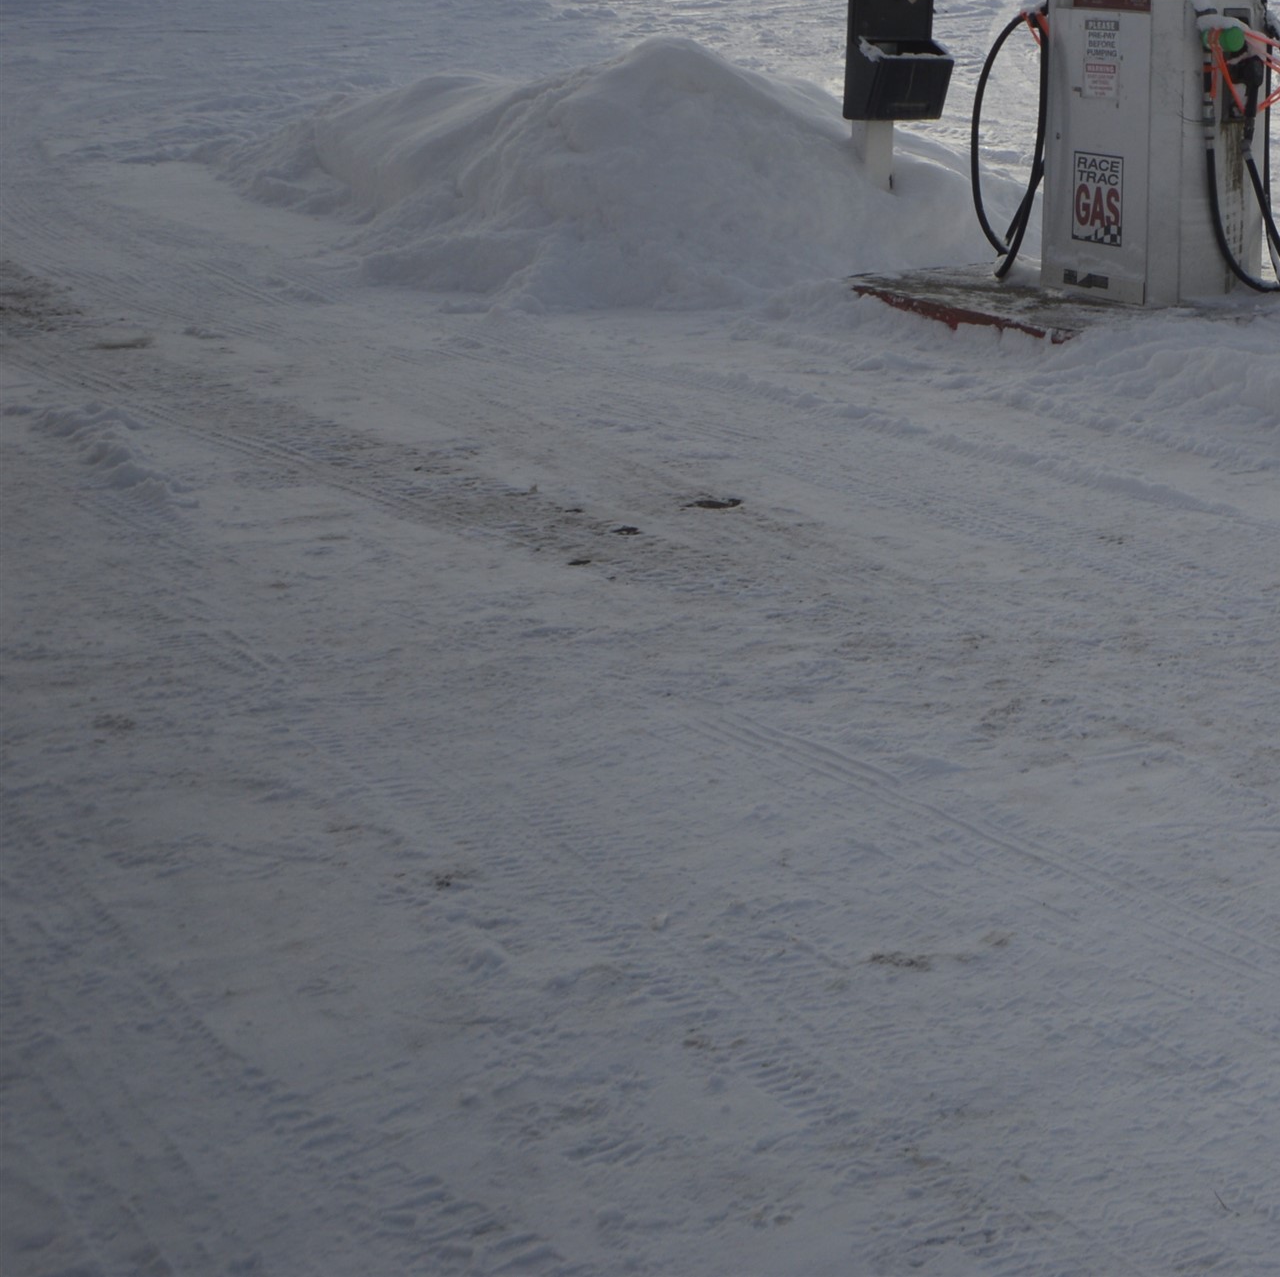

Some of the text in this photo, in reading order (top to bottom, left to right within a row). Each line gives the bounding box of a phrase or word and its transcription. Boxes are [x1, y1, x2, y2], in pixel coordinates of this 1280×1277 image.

[1089, 21, 1116, 30] PLEASE
[1088, 32, 1116, 40] PRE-PAY
[1088, 40, 1116, 49] BEFORE
[1087, 49, 1117, 57] PUMPING
[1077, 156, 1120, 174] RACE
[1077, 169, 1119, 186] TRAC
[1075, 183, 1120, 228] GAS
